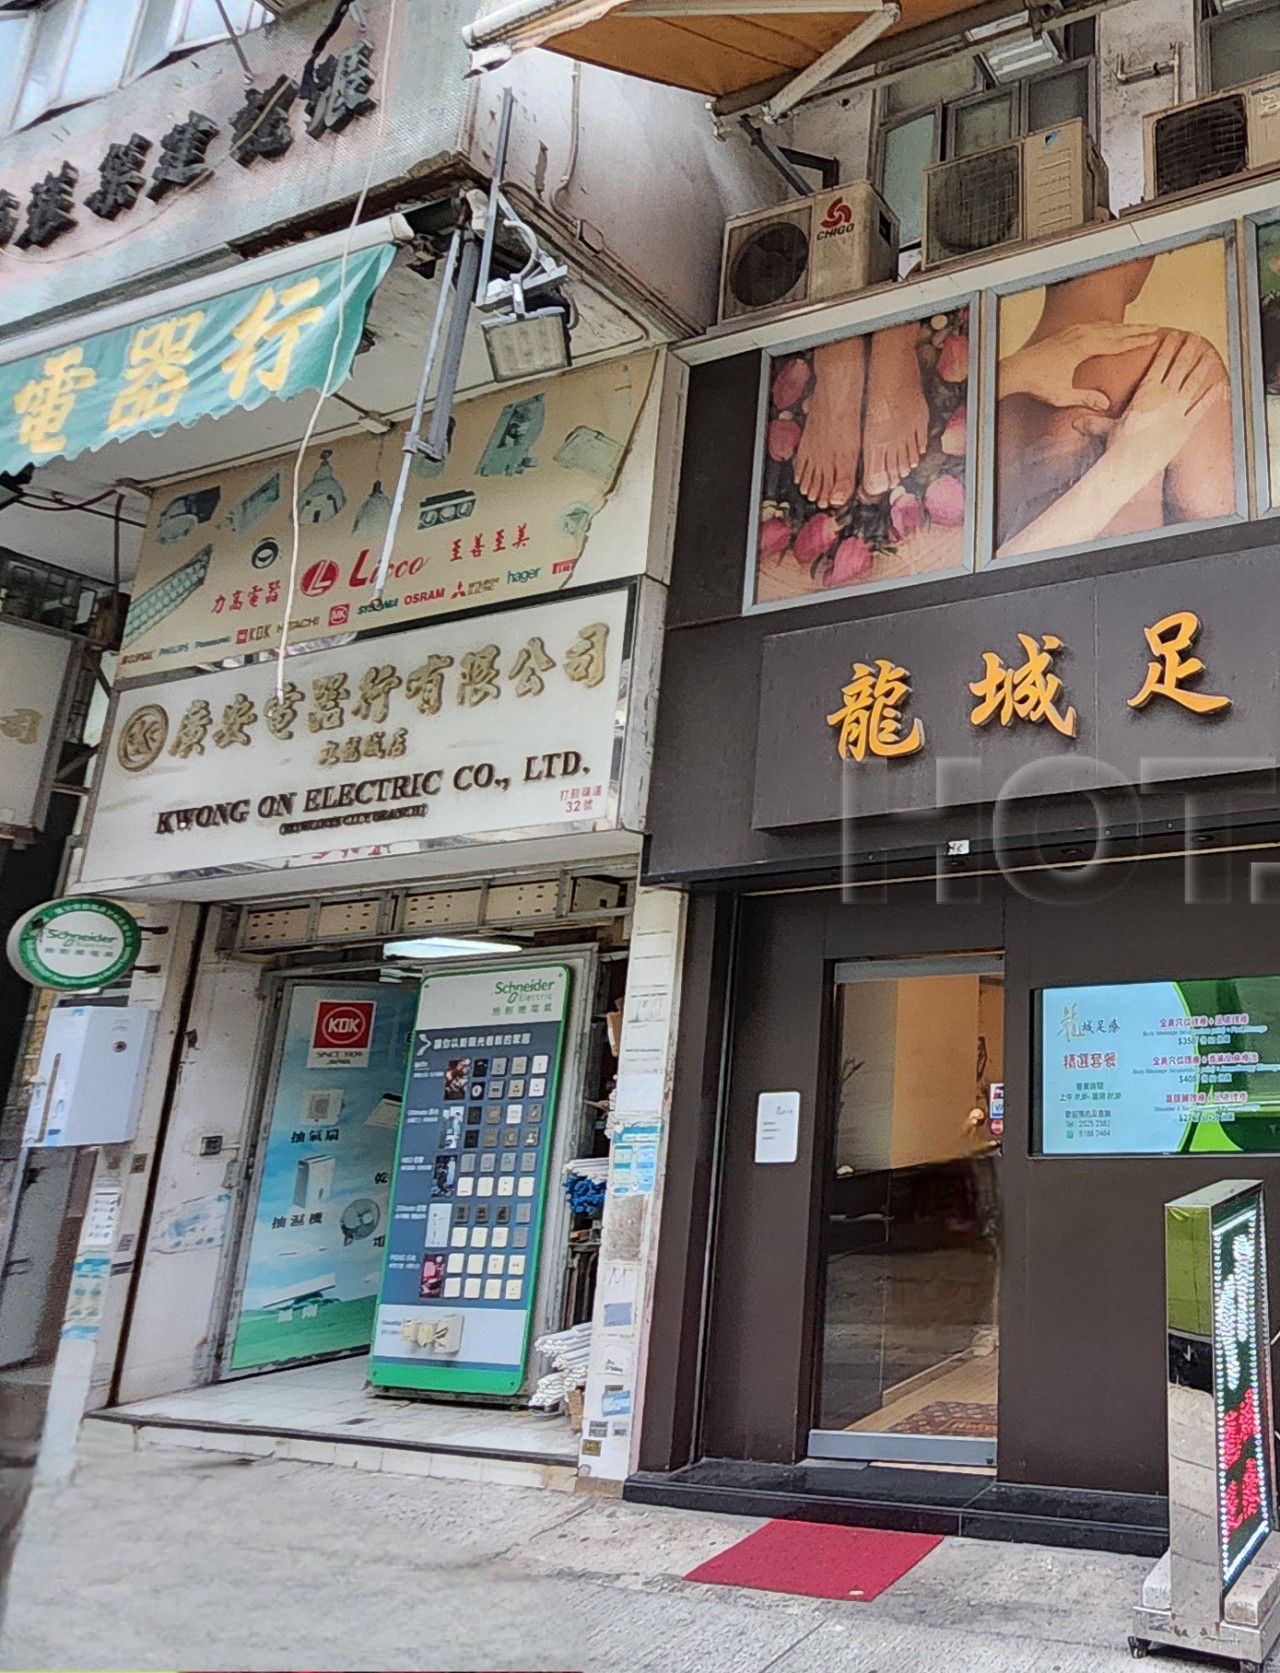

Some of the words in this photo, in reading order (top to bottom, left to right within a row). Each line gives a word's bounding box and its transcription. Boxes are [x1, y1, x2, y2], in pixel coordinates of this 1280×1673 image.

[817, 223, 855, 241] CHIGO
[14, 277, 325, 454] 電器行
[450, 522, 531, 562] 至善至美
[276, 616, 320, 634] HTACHI
[404, 587, 446, 606] OSRAM
[507, 567, 542, 585] hager
[168, 622, 609, 759] 廣安電器行有限公司
[155, 799, 250, 834] KWONG
[257, 792, 297, 818] ON
[303, 769, 444, 812] ELECTRIC
[453, 763, 511, 792] CO.,
[524, 751, 591, 781] LTD.
[495, 977, 556, 995] Schneider
[290, 1128, 340, 1144] 抽氣扇
